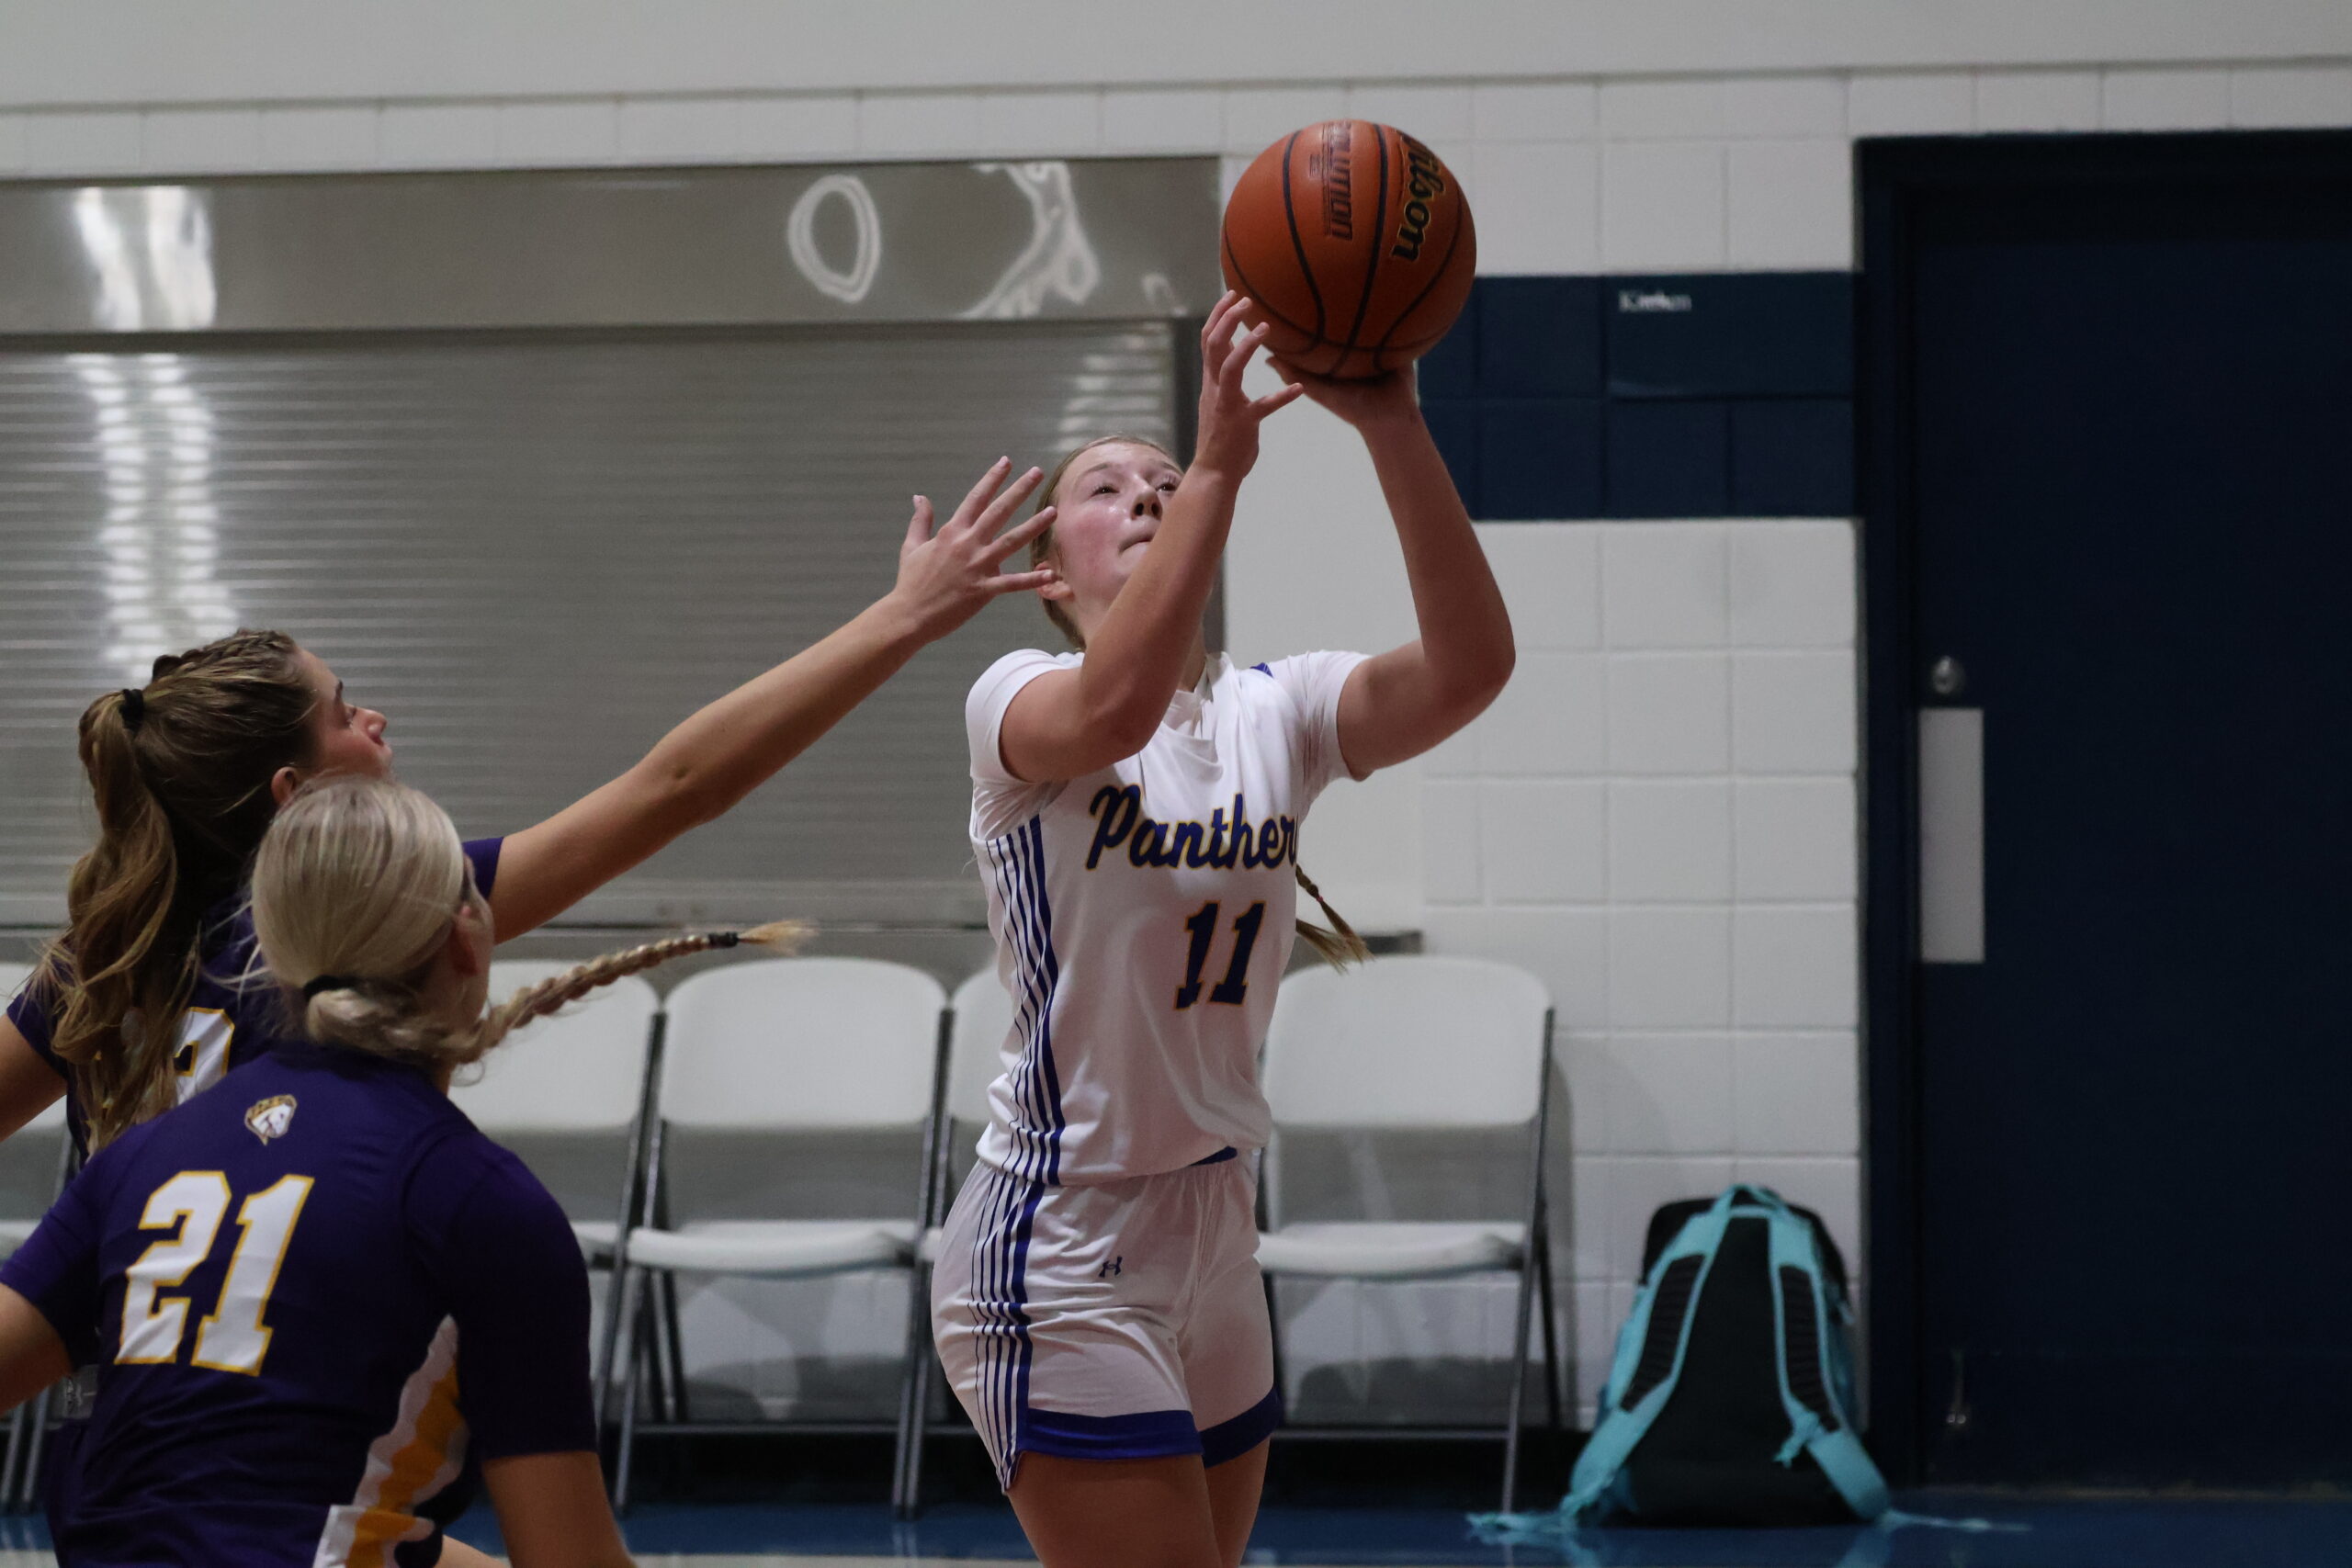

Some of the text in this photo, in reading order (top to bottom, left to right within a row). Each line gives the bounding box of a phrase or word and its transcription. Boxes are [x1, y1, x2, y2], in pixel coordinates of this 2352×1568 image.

[1391, 127, 1446, 263] ilson
[1085, 784, 1298, 871] Panther
[1173, 899, 1267, 1010] 11
[114, 1169, 316, 1377] 21
